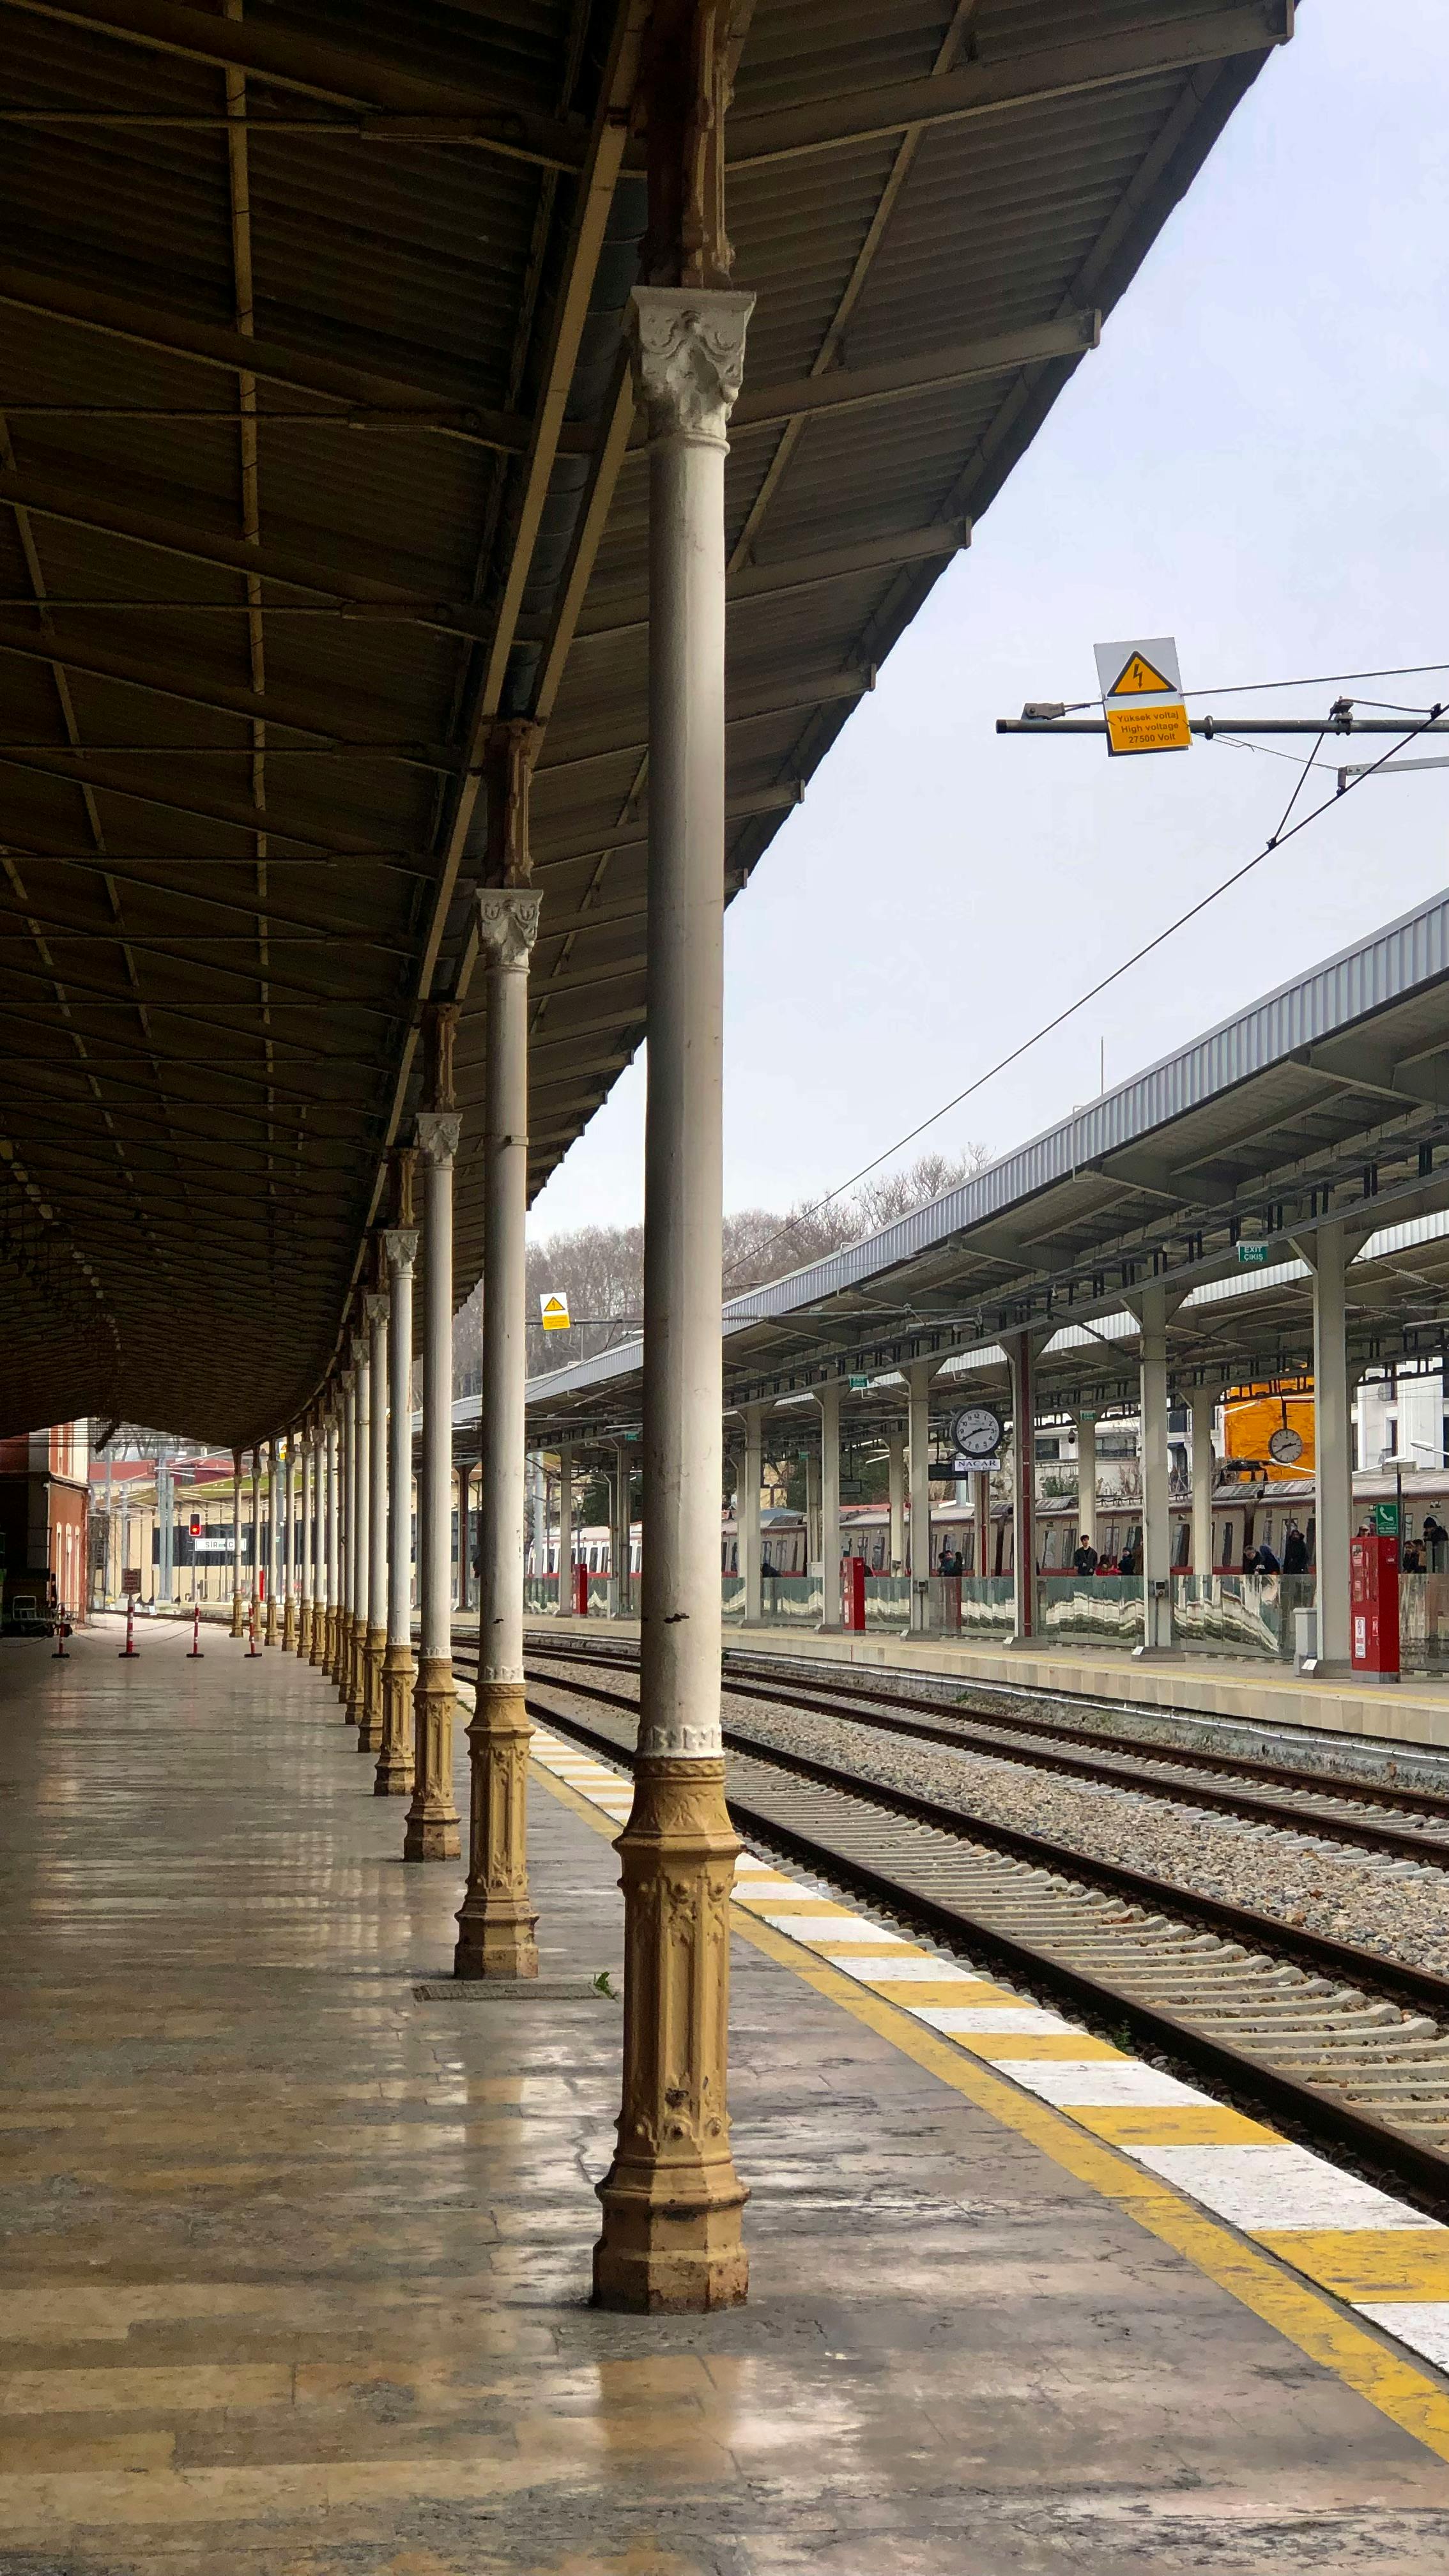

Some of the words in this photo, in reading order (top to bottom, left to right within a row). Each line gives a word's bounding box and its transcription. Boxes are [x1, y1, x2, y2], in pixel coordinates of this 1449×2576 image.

[1117, 714, 1151, 723] Yüksek
[1153, 711, 1179, 719] voltaj
[1121, 725, 1143, 733] High
[1146, 723, 1179, 731] voltage
[1128, 735, 1155, 744] 27500
[1158, 733, 1176, 741] Volt
[1243, 1254, 1264, 1262] ÇIKIŞ
